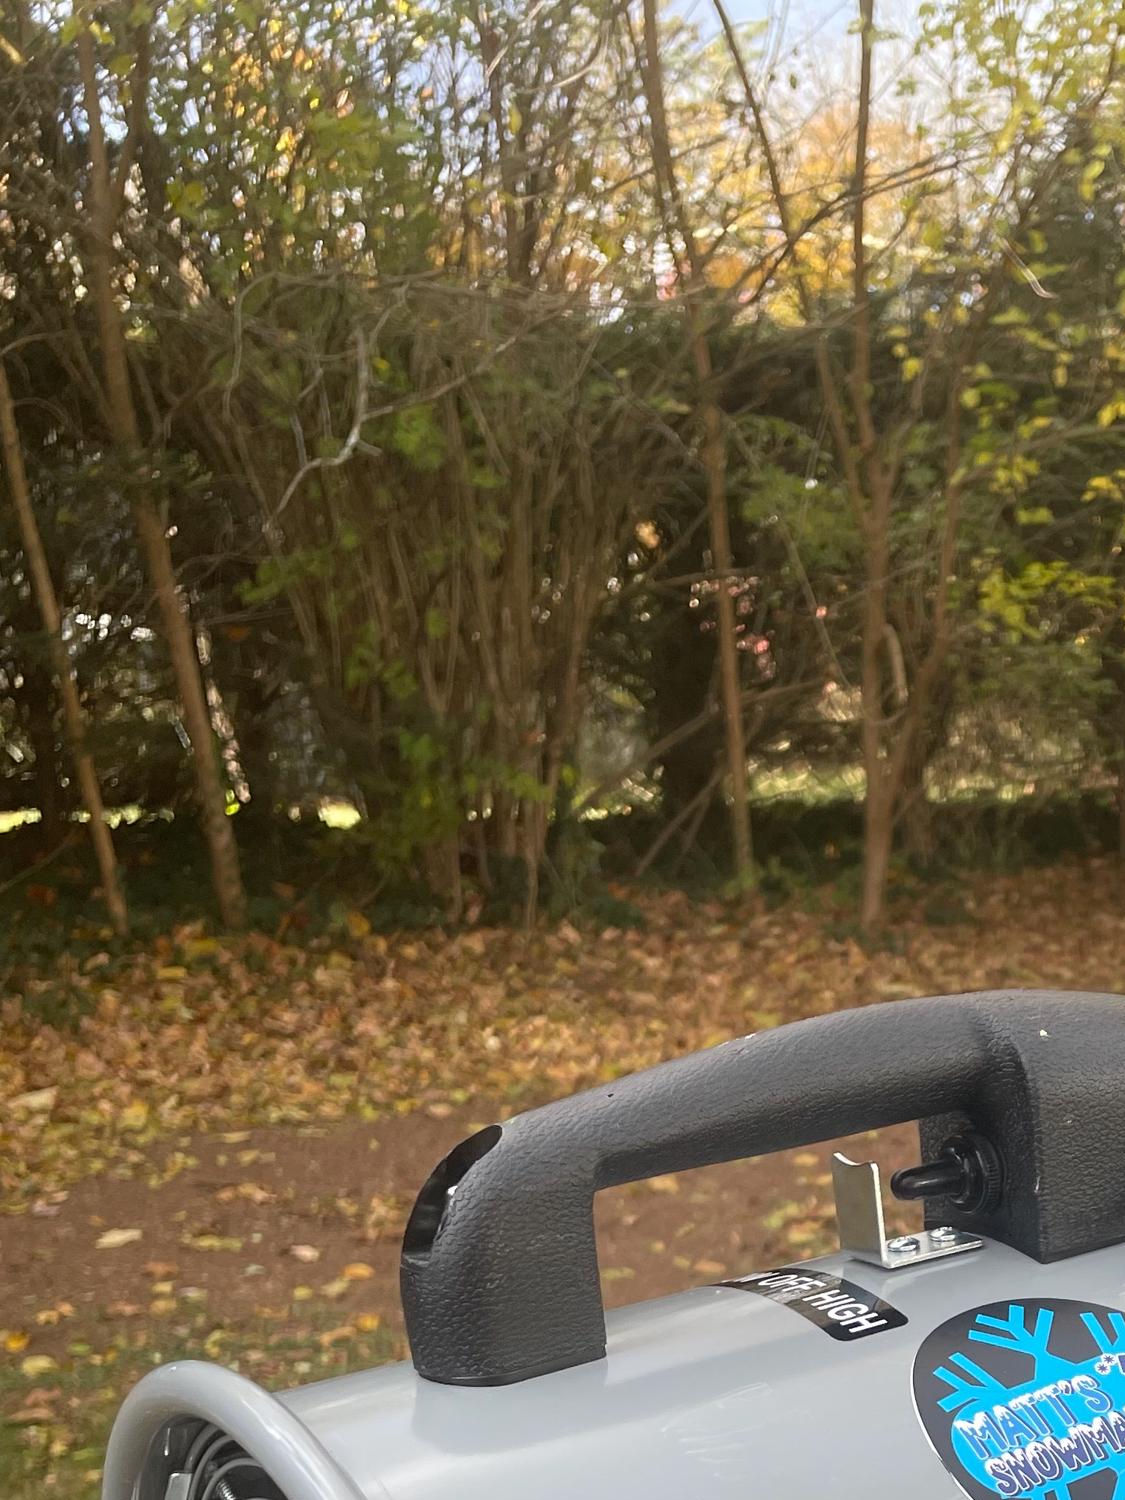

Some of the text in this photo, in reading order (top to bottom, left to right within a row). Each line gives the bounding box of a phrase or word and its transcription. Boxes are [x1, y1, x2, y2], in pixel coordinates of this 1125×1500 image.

[758, 1273, 827, 1292] OFF
[802, 1289, 888, 1333] HIGH
[952, 1374, 1112, 1460] MATT'S
